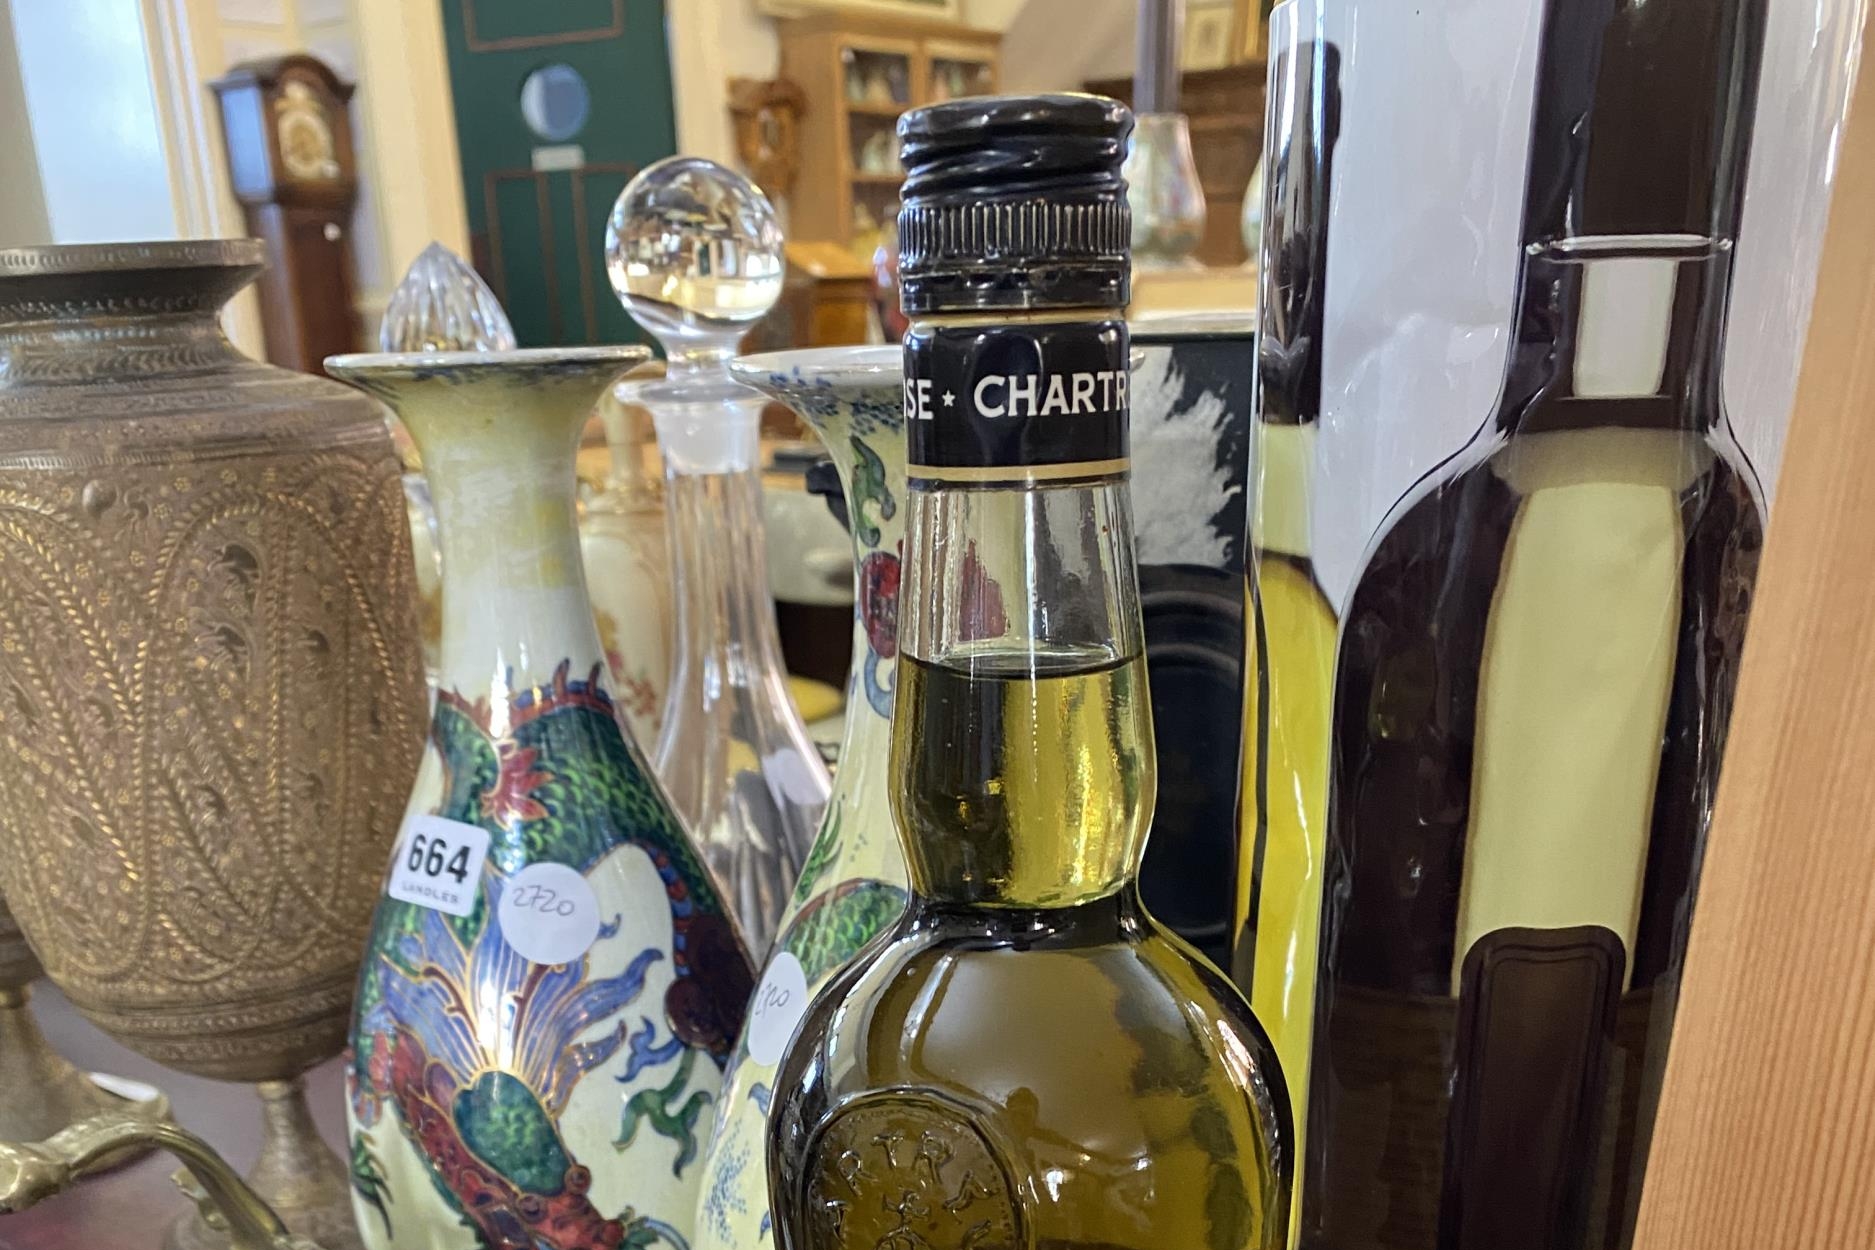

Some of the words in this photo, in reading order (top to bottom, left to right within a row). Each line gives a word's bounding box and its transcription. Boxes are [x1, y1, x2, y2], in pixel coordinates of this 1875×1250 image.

[903, 377, 935, 420] SE
[407, 834, 471, 885] 664
[513, 884, 576, 917] 2720
